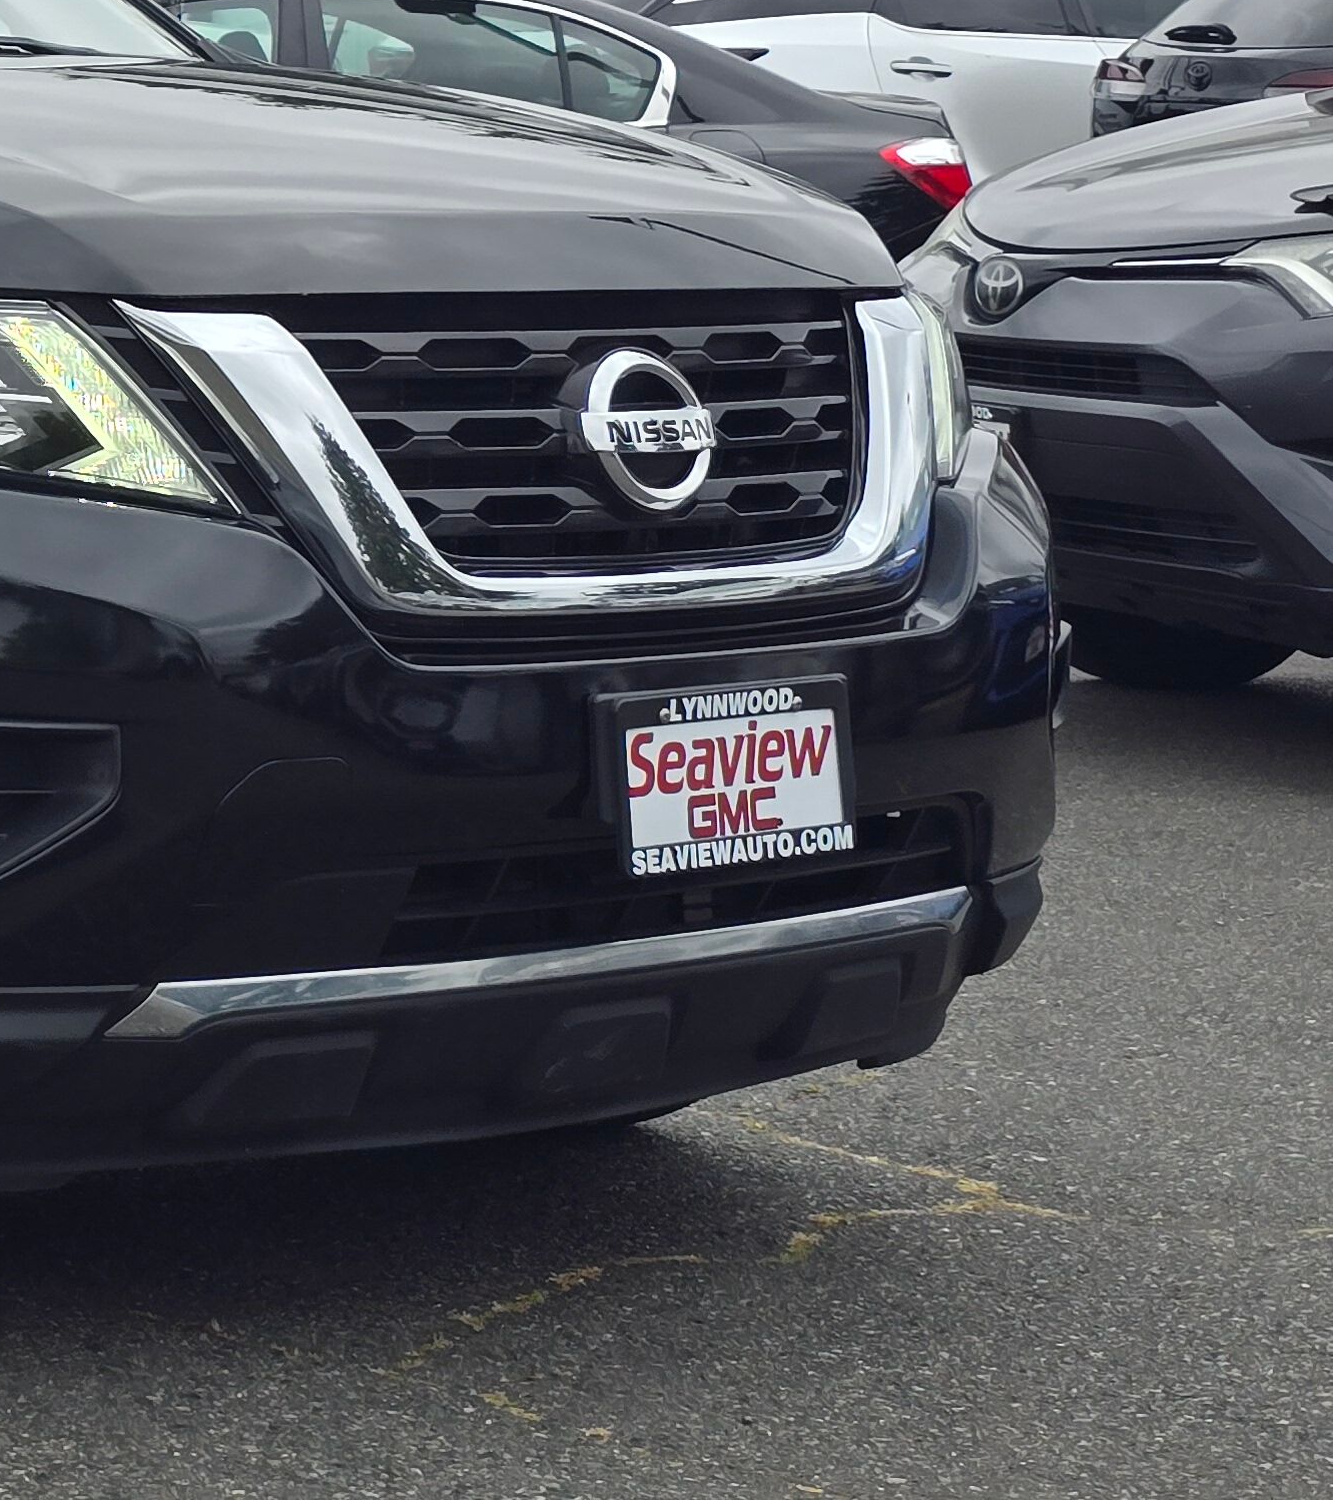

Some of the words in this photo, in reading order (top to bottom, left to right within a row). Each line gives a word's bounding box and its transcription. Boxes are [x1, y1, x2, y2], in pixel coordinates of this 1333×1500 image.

[606, 417, 713, 445] NISSAN
[669, 687, 795, 722] LYNNWOOD
[628, 719, 831, 798] Seaview
[688, 787, 783, 839] GMC
[632, 824, 854, 877] SEAVIEWAUTO.COM
